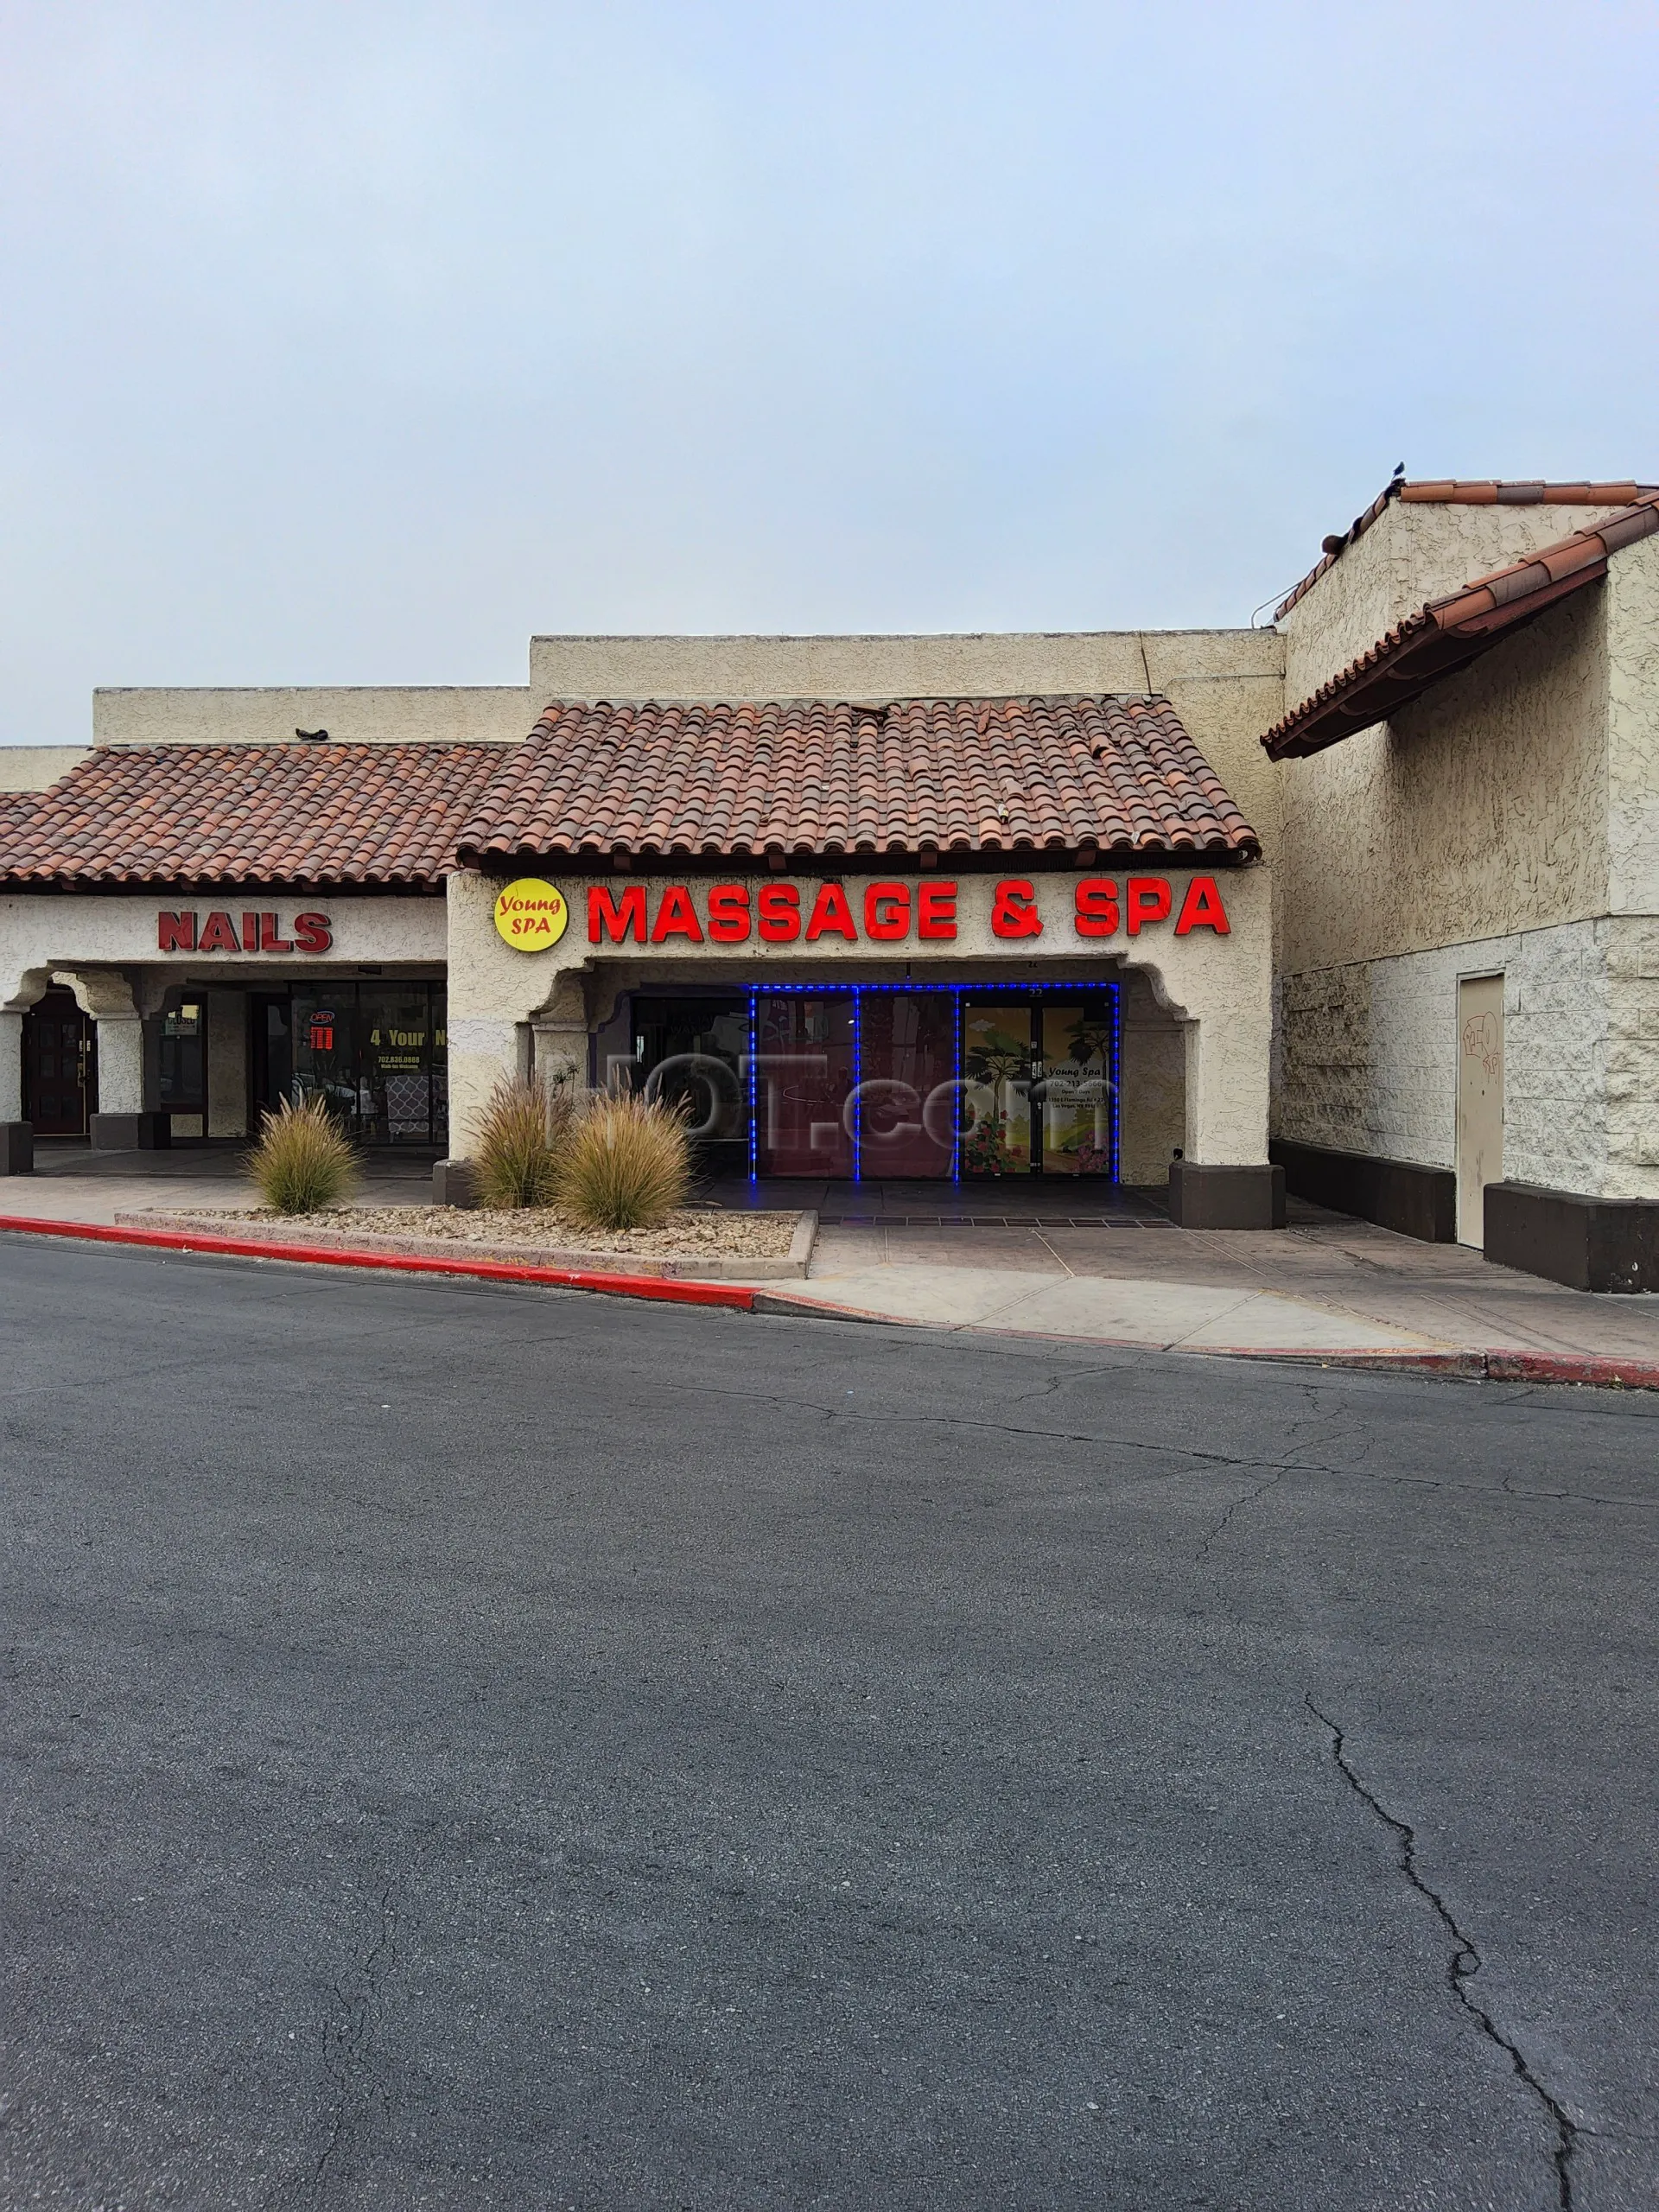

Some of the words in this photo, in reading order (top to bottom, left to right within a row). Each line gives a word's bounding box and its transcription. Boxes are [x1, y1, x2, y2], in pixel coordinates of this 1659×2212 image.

[499, 895, 562, 916] Young
[588, 881, 958, 944] MASSAGE
[991, 880, 1044, 938] &
[1075, 877, 1231, 937] SPA
[158, 911, 334, 953] NAILS
[511, 918, 551, 935] SPA
[1028, 988, 1043, 997] 22
[311, 1013, 333, 1022] OPEN
[370, 1029, 381, 1046] 4
[388, 1029, 425, 1046] Your
[1048, 1066, 1079, 1077] Young
[1082, 1067, 1101, 1077] Spa
